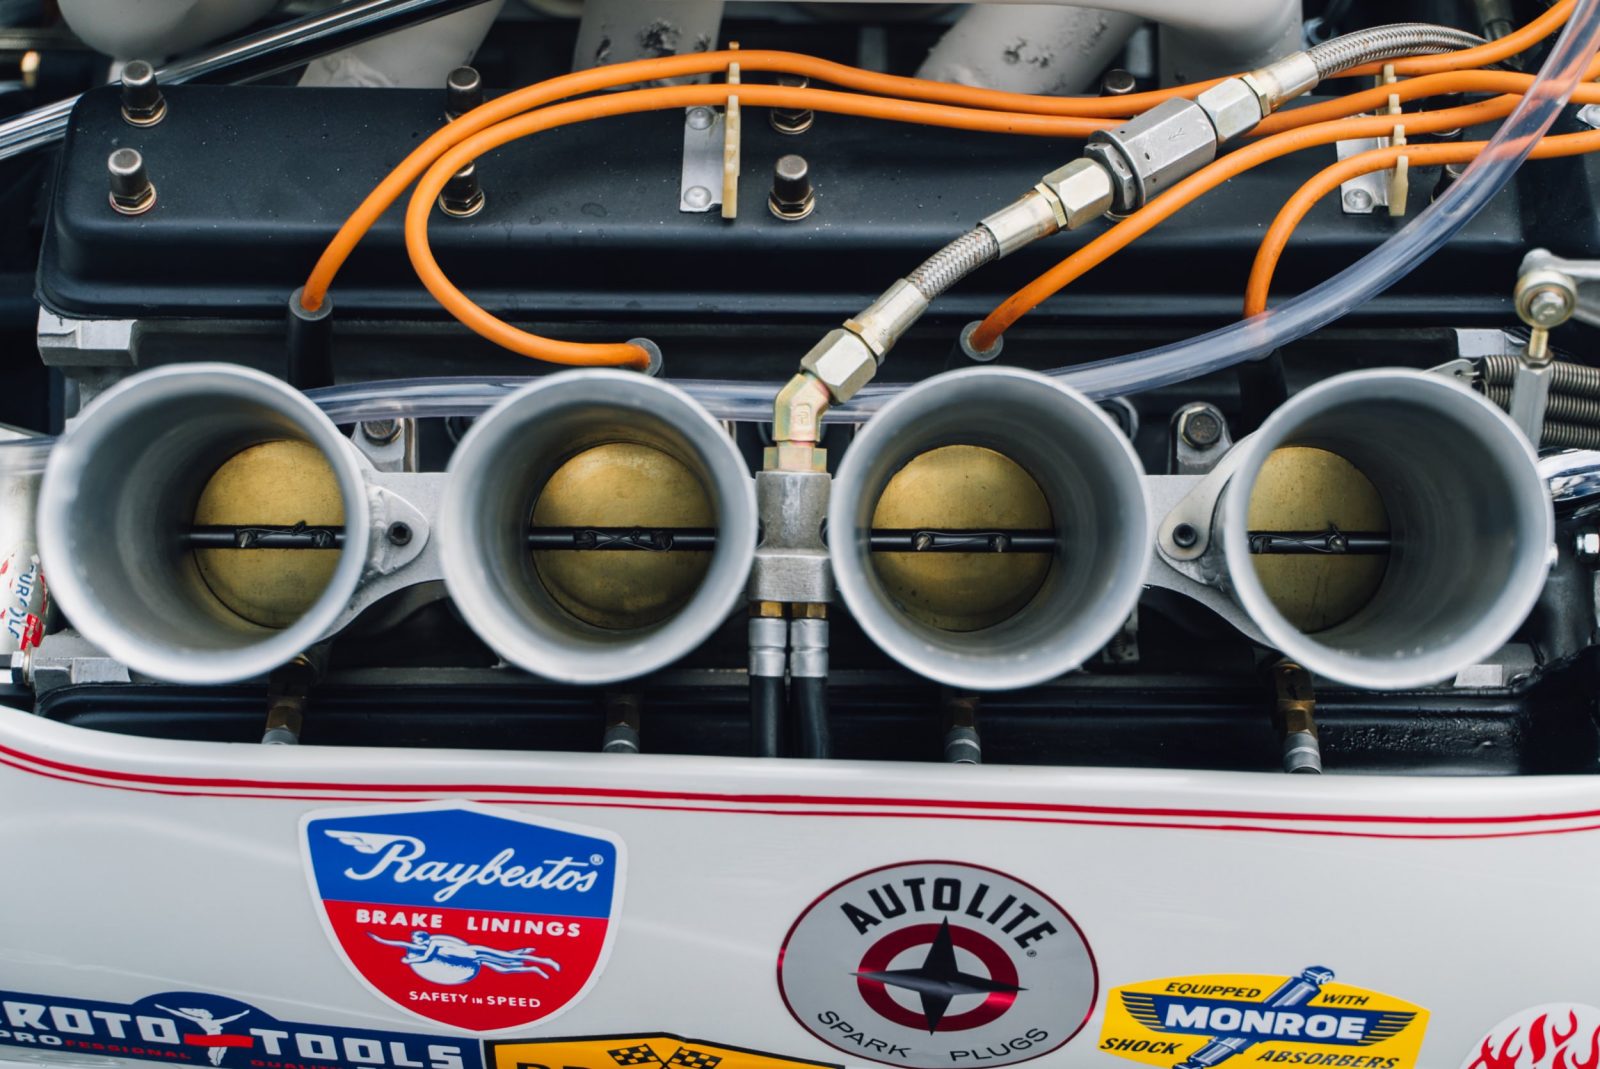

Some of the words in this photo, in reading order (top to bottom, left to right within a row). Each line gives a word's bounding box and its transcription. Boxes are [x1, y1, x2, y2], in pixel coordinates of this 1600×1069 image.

[324, 829, 598, 902] Raybestos
[356, 909, 443, 928] BRAKE
[467, 916, 581, 937] LININGS
[840, 877, 1057, 949] AUTOLITE
[409, 991, 469, 1004] SAFETY
[487, 995, 541, 1008] SPEED
[1164, 982, 1261, 999] EQUIPPED
[1321, 993, 1370, 1006] WITH
[0, 1000, 181, 1045] ROTO
[250, 1028, 464, 1069] TOOLS
[817, 1010, 912, 1058] SPARK
[950, 1028, 1049, 1061] PLUGS
[1165, 1004, 1366, 1040] MONROE
[1100, 1037, 1184, 1055] SHOCK
[1256, 1049, 1400, 1069] ABSORBERS
